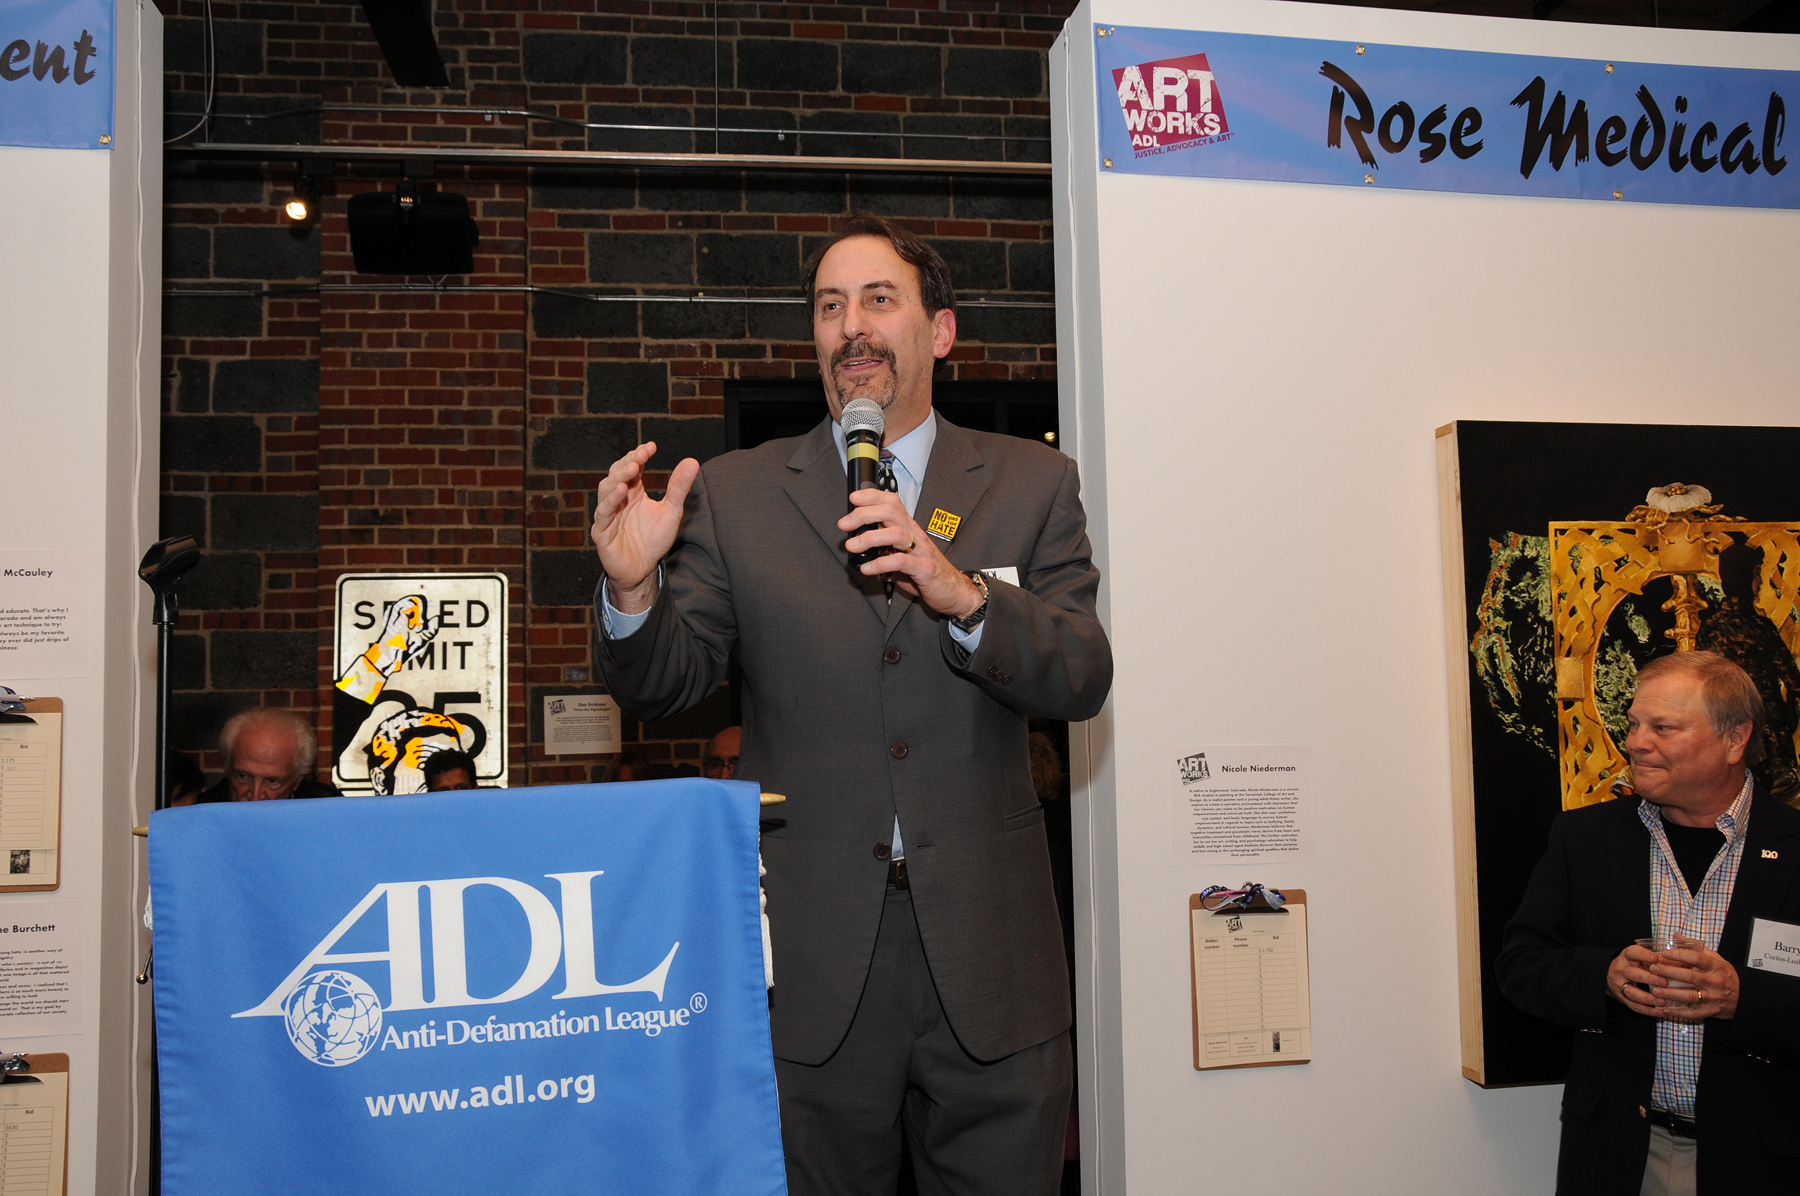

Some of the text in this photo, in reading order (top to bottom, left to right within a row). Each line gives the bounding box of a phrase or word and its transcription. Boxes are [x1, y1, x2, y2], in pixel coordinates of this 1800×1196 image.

[0, 29, 97, 85] ent
[1118, 65, 1215, 113] ART
[1122, 108, 1221, 136] WORKS
[1319, 61, 1787, 179] Rose Medical
[1132, 134, 1161, 147] ADL
[1134, 146, 1166, 159] JUSTICE,
[1166, 138, 1208, 153] ADVOCACY
[930, 519, 956, 536] HATE
[934, 509, 948, 523] NO
[4, 568, 53, 578] McCauley
[353, 599, 490, 630] SED
[369, 641, 473, 670] MIT
[1179, 757, 1206, 771] ART
[1222, 764, 1296, 773] Nicole Niederman
[12, 924, 56, 934] Burchett
[231, 870, 680, 1019] ADL
[1774, 941, 1800, 957] Barry
[380, 1010, 600, 1052] Anti-Defamation
[365, 1072, 597, 1118] www.adl.org
